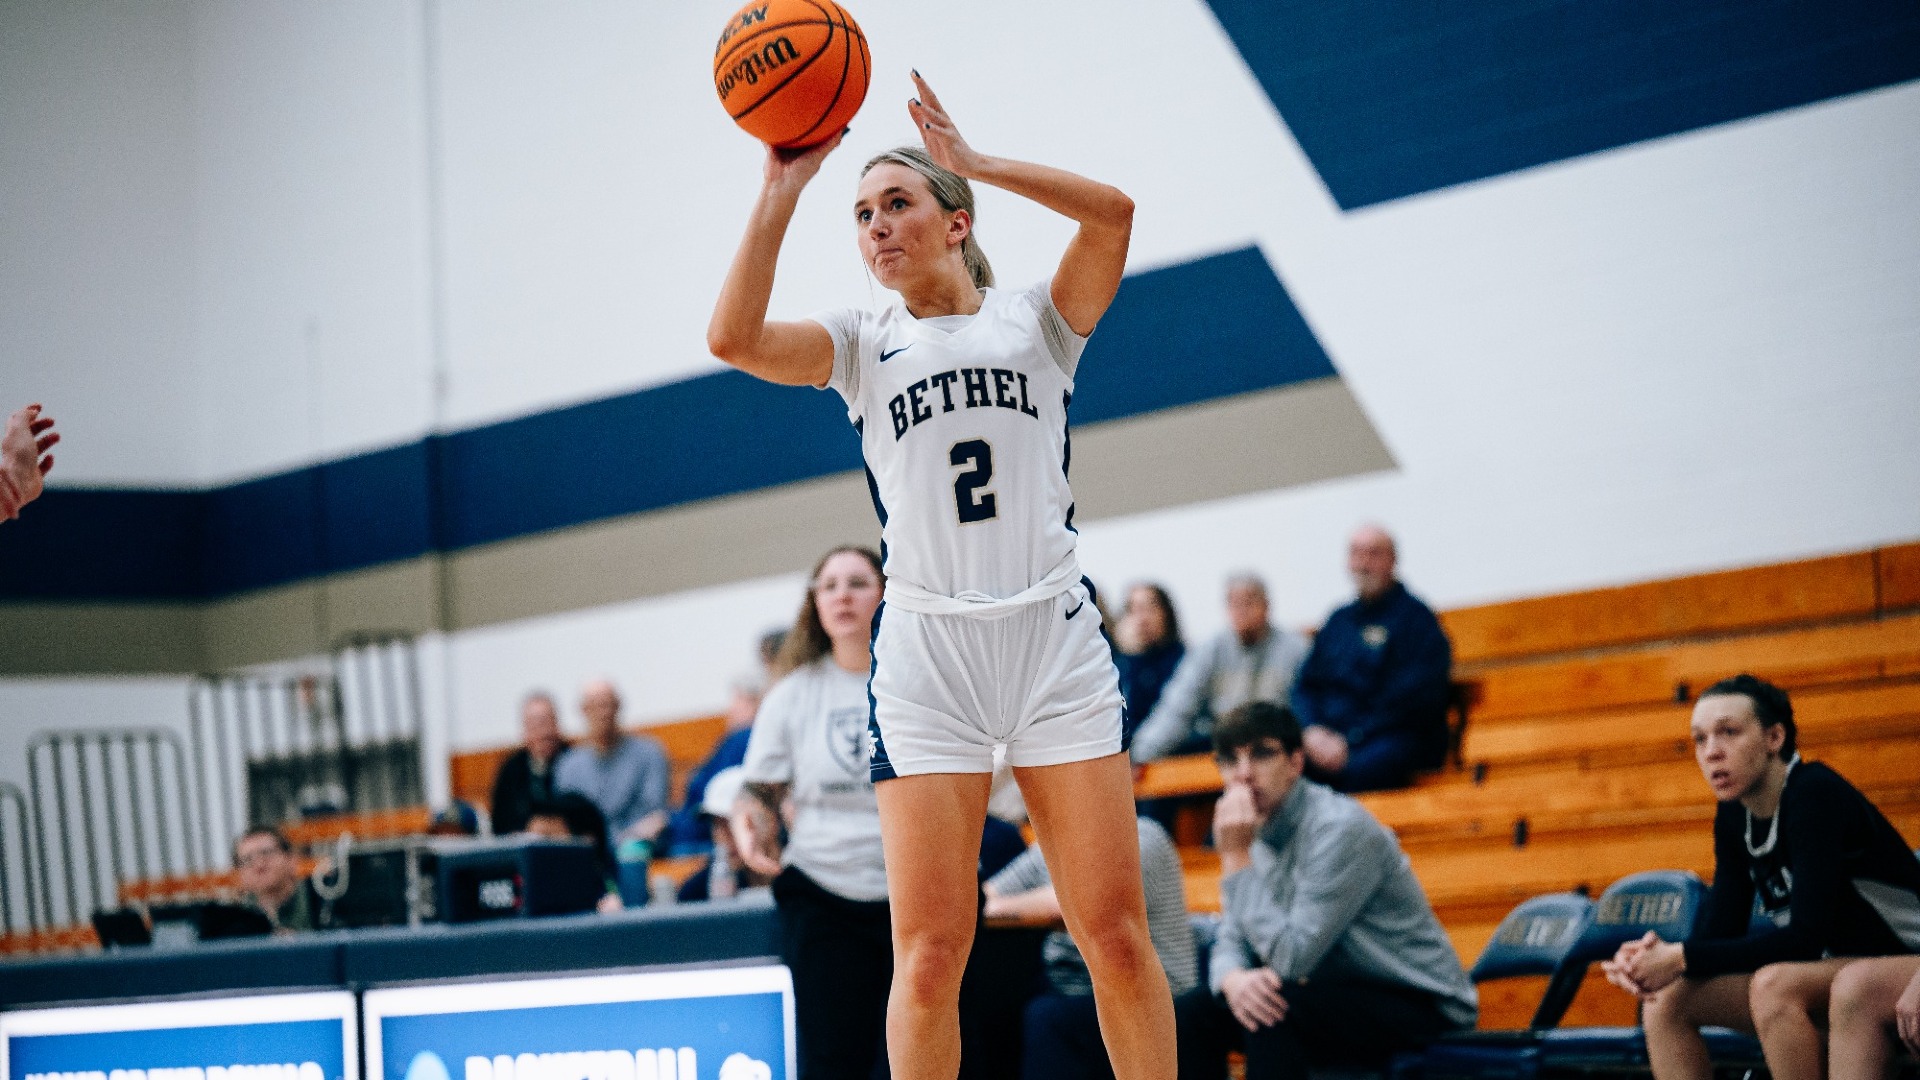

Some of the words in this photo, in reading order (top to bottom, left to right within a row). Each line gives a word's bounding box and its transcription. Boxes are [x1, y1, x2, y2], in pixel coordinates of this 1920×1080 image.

[717, 36, 799, 100] Wilson
[889, 368, 1038, 442] BETHEL
[949, 438, 998, 525] 2
